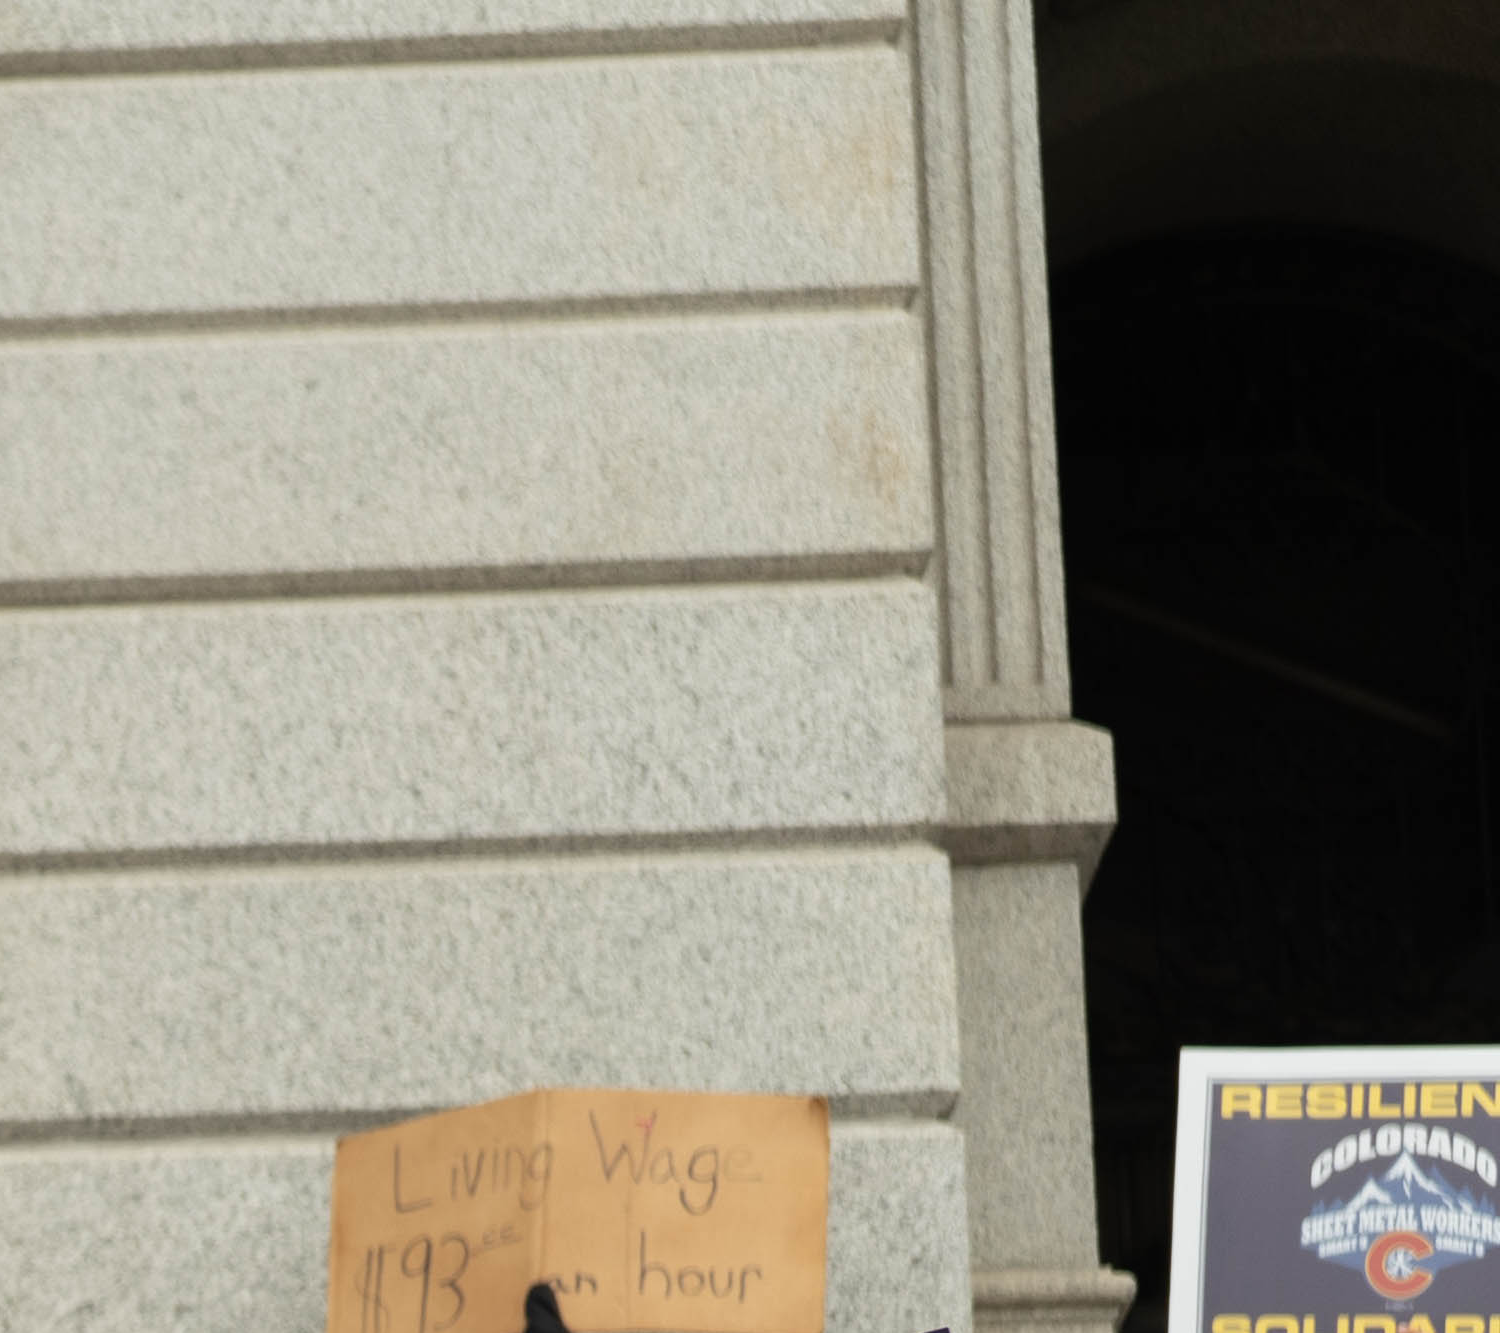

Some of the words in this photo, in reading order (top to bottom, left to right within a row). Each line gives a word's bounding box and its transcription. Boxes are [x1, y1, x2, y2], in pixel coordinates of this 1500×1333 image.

[589, 1108, 764, 1216] Wage
[1310, 1123, 1498, 1189] COLORADO
[1301, 1210, 1353, 1247] SHEET
[1358, 1202, 1418, 1234] METAL
[638, 1229, 764, 1302] hour
